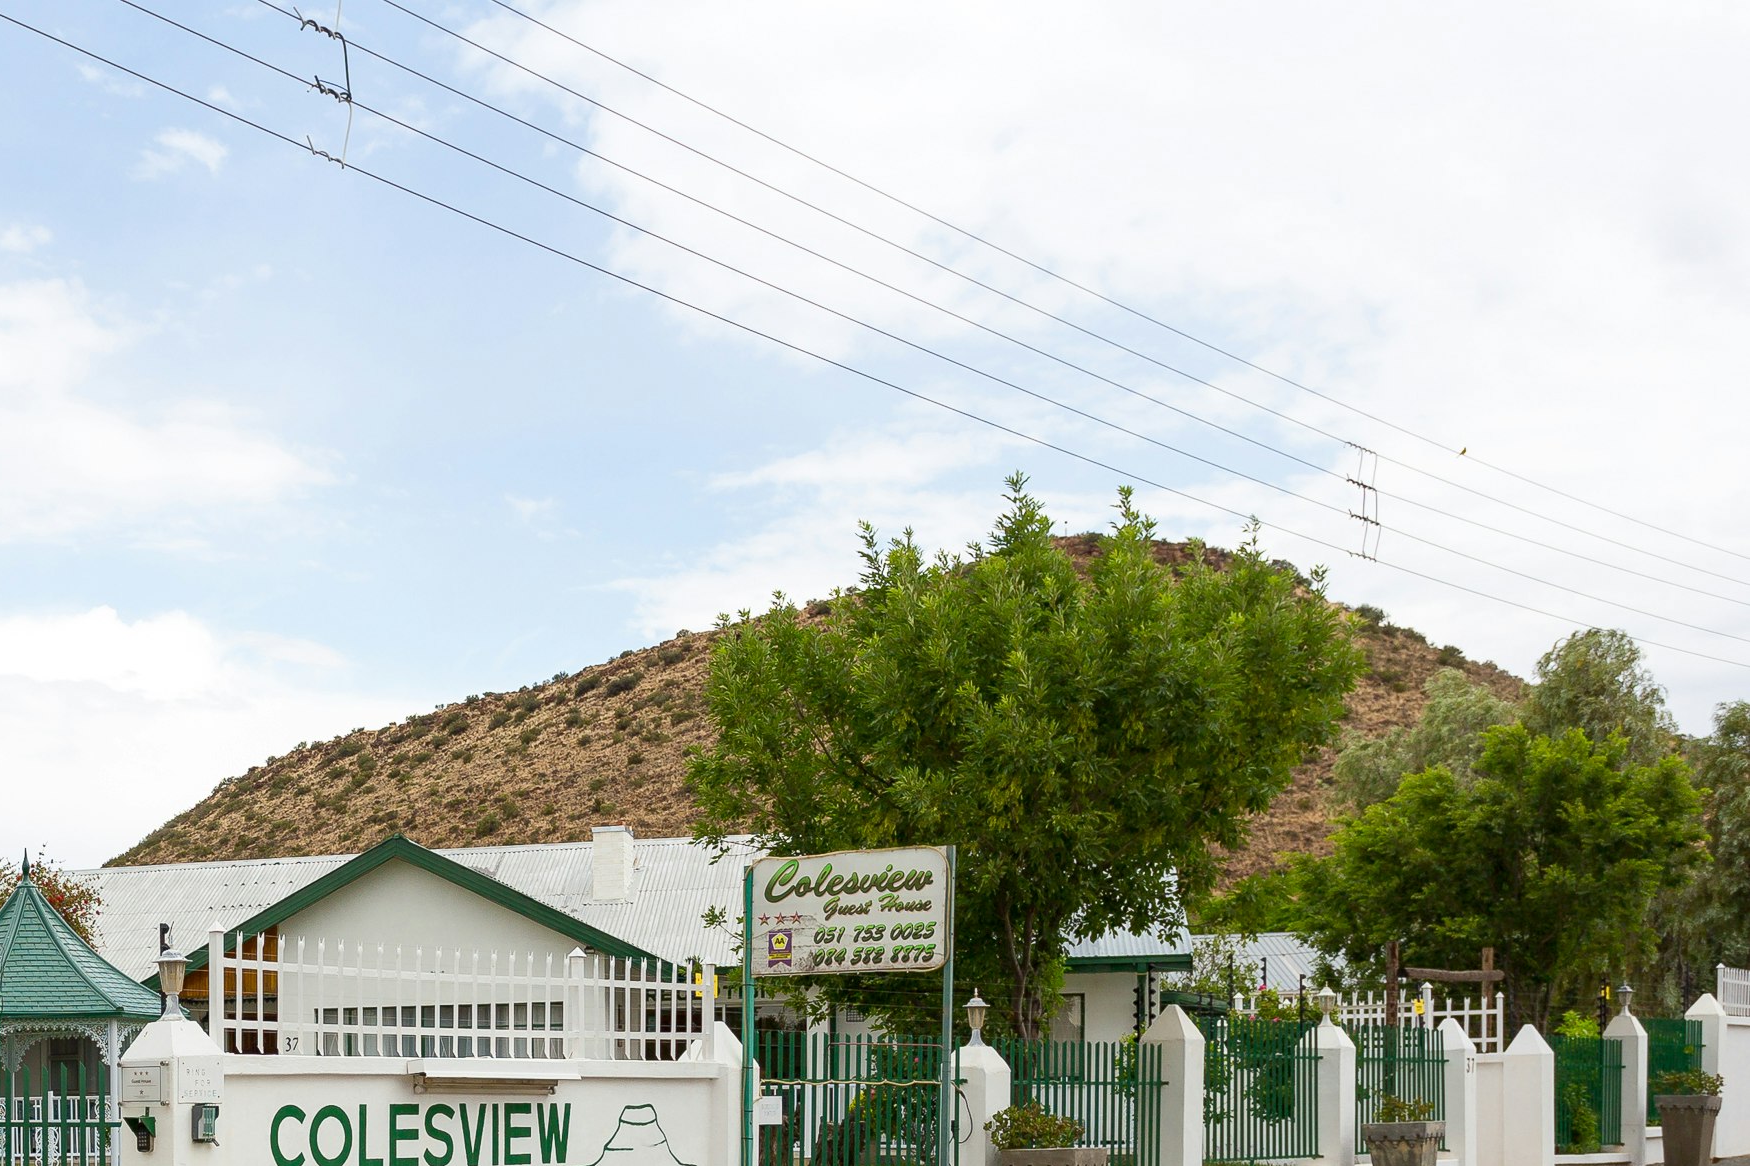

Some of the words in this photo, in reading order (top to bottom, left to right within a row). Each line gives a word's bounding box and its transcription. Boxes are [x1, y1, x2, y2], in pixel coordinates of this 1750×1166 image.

[764, 859, 933, 903] Colesview
[823, 895, 873, 921] Guest
[878, 892, 933, 912] House
[813, 926, 846, 944] 051
[853, 924, 887, 943] 753
[890, 921, 937, 941] 0025
[774, 937, 785, 945] AA
[813, 947, 847, 967] 084
[850, 945, 885, 965] 582
[890, 943, 937, 963] 8875
[285, 1036, 299, 1052] 37
[186, 1068, 206, 1077] RING
[194, 1079, 211, 1087] FOR
[184, 1089, 218, 1097] SERVICE
